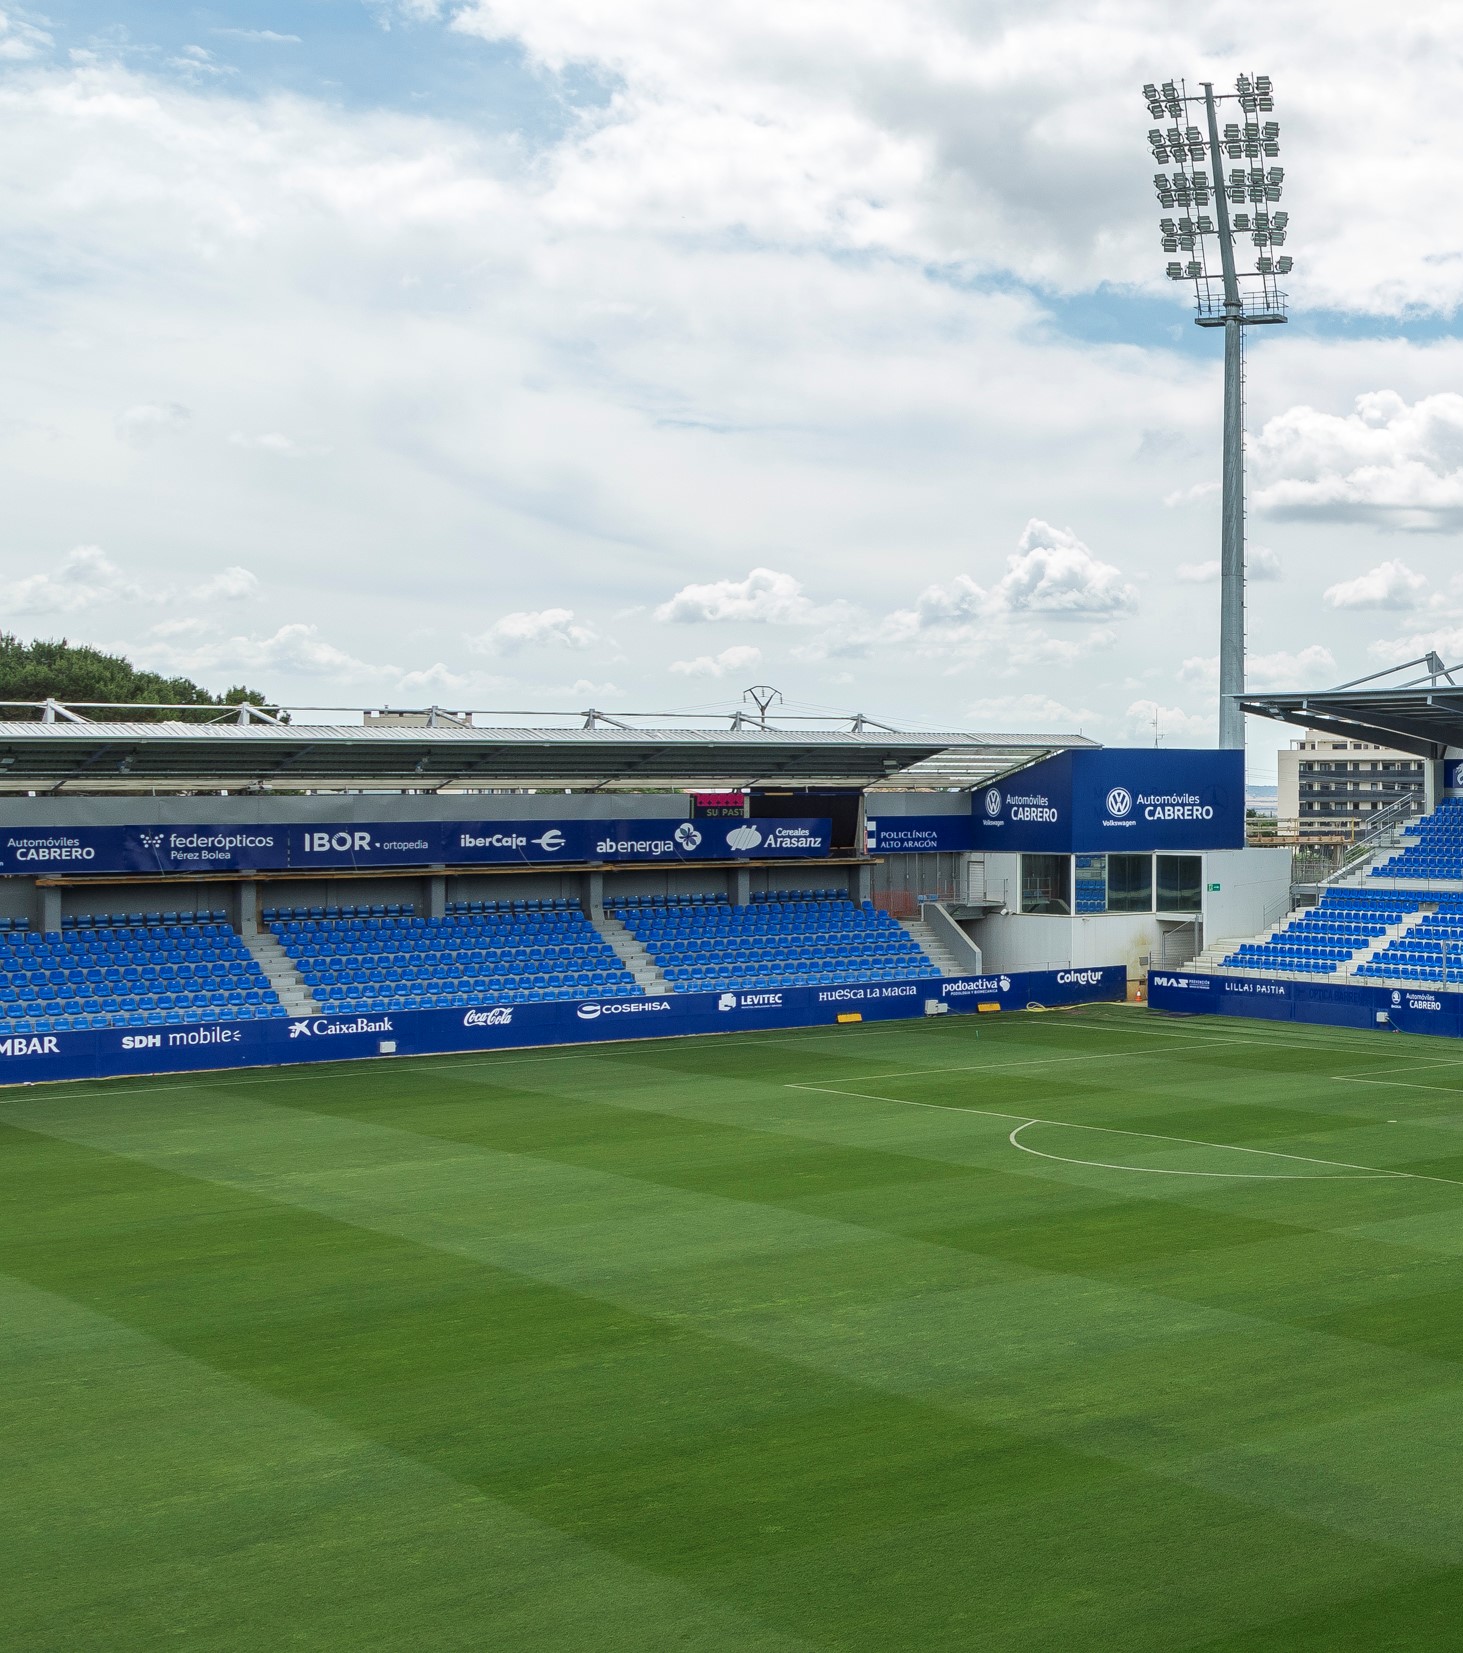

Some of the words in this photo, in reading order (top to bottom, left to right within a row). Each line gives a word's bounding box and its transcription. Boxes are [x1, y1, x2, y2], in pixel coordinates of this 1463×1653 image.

[1005, 794, 1049, 806] Automóviles
[1136, 793, 1200, 805] Automóviles
[707, 808, 719, 817] SU
[1011, 807, 1058, 822] CABRERO
[1144, 805, 1213, 820] CABRERO
[1102, 819, 1137, 827] Volkswagen
[775, 827, 810, 836] Cereales
[880, 829, 938, 839] POLICLÍNICA
[7, 837, 80, 847] Automóviles
[170, 833, 274, 850] federópticos
[304, 832, 371, 852] IBOR
[383, 840, 429, 851] ortopedia
[460, 834, 527, 849] iberCaja
[764, 834, 822, 848] Arasanz
[880, 840, 901, 848] ALTO
[902, 839, 938, 848] ARAGÓN
[16, 847, 95, 861] CABRERO
[170, 850, 199, 860] Pérez
[201, 850, 231, 860] Bolea
[1057, 970, 1103, 984] Colnatur
[1154, 976, 1189, 988] MAZ
[942, 978, 998, 997] podoactiva
[1225, 982, 1253, 992] LILLAS
[1256, 984, 1285, 995] PASTIA
[741, 993, 783, 1005] LEVITEC
[1406, 993, 1435, 1001] Automóviles
[602, 1002, 671, 1014] COSEHISA
[1409, 1000, 1441, 1010] CABRERO
[313, 1017, 393, 1035] CaixaBank
[121, 1034, 161, 1049] SDH
[169, 1026, 233, 1046] mobile
